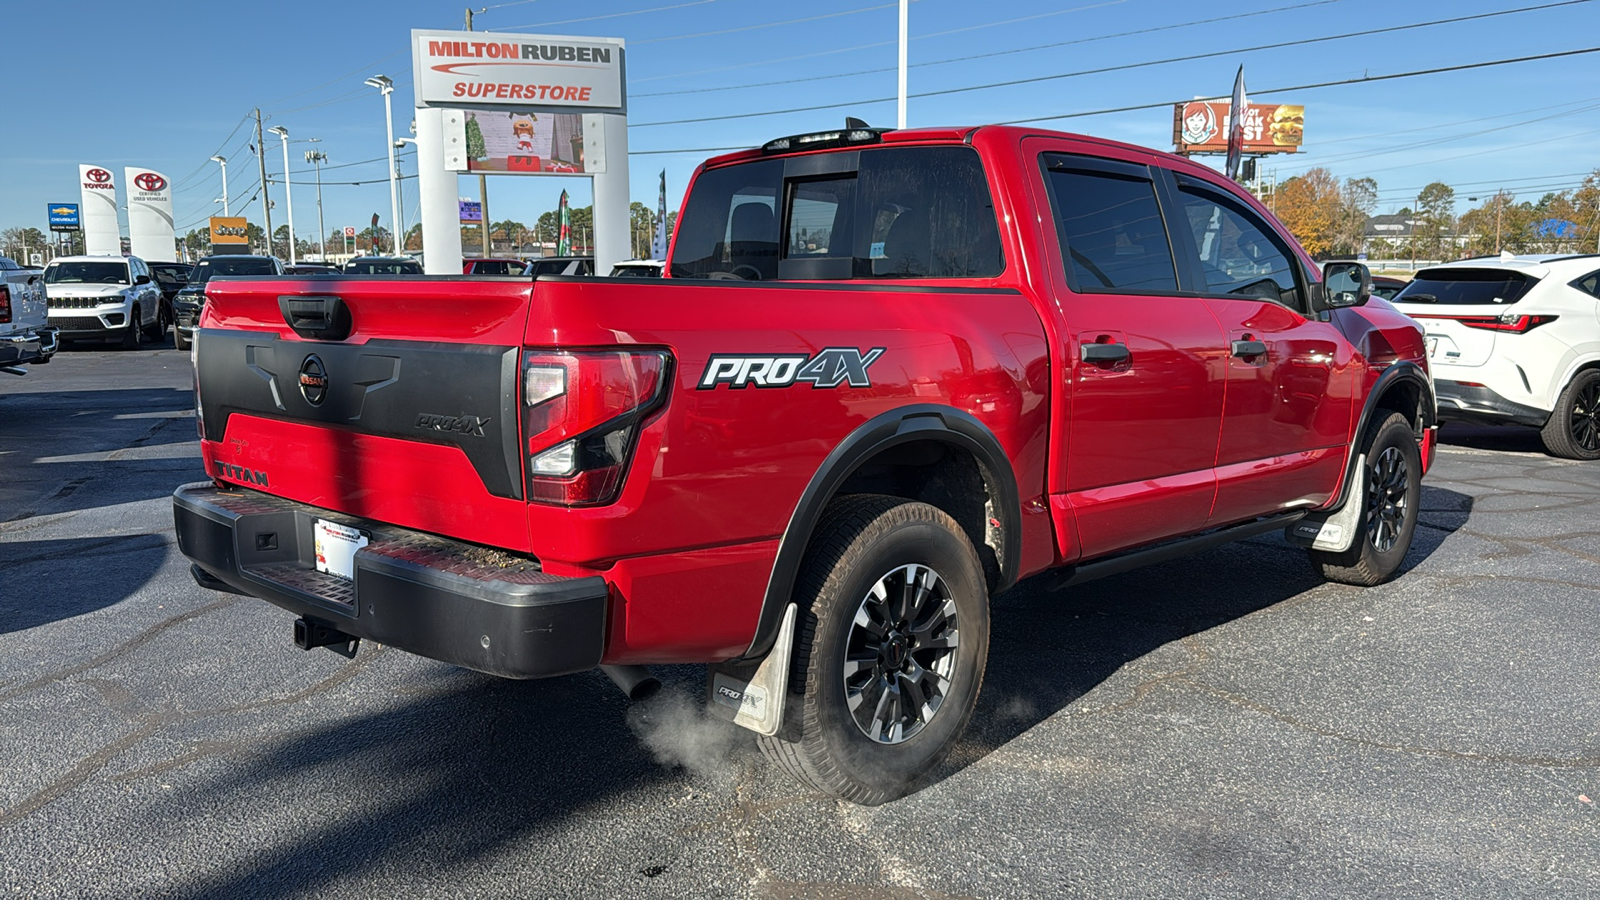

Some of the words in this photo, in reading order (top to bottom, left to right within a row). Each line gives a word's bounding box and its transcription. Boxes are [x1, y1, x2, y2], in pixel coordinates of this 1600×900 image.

[429, 40, 519, 59] MILTON
[521, 44, 611, 63] RUBEN
[453, 82, 592, 102] SUPERSTORE
[83, 182, 115, 190] TOYOTA
[214, 224, 247, 237] Jeep
[214, 460, 269, 487] TITAN
